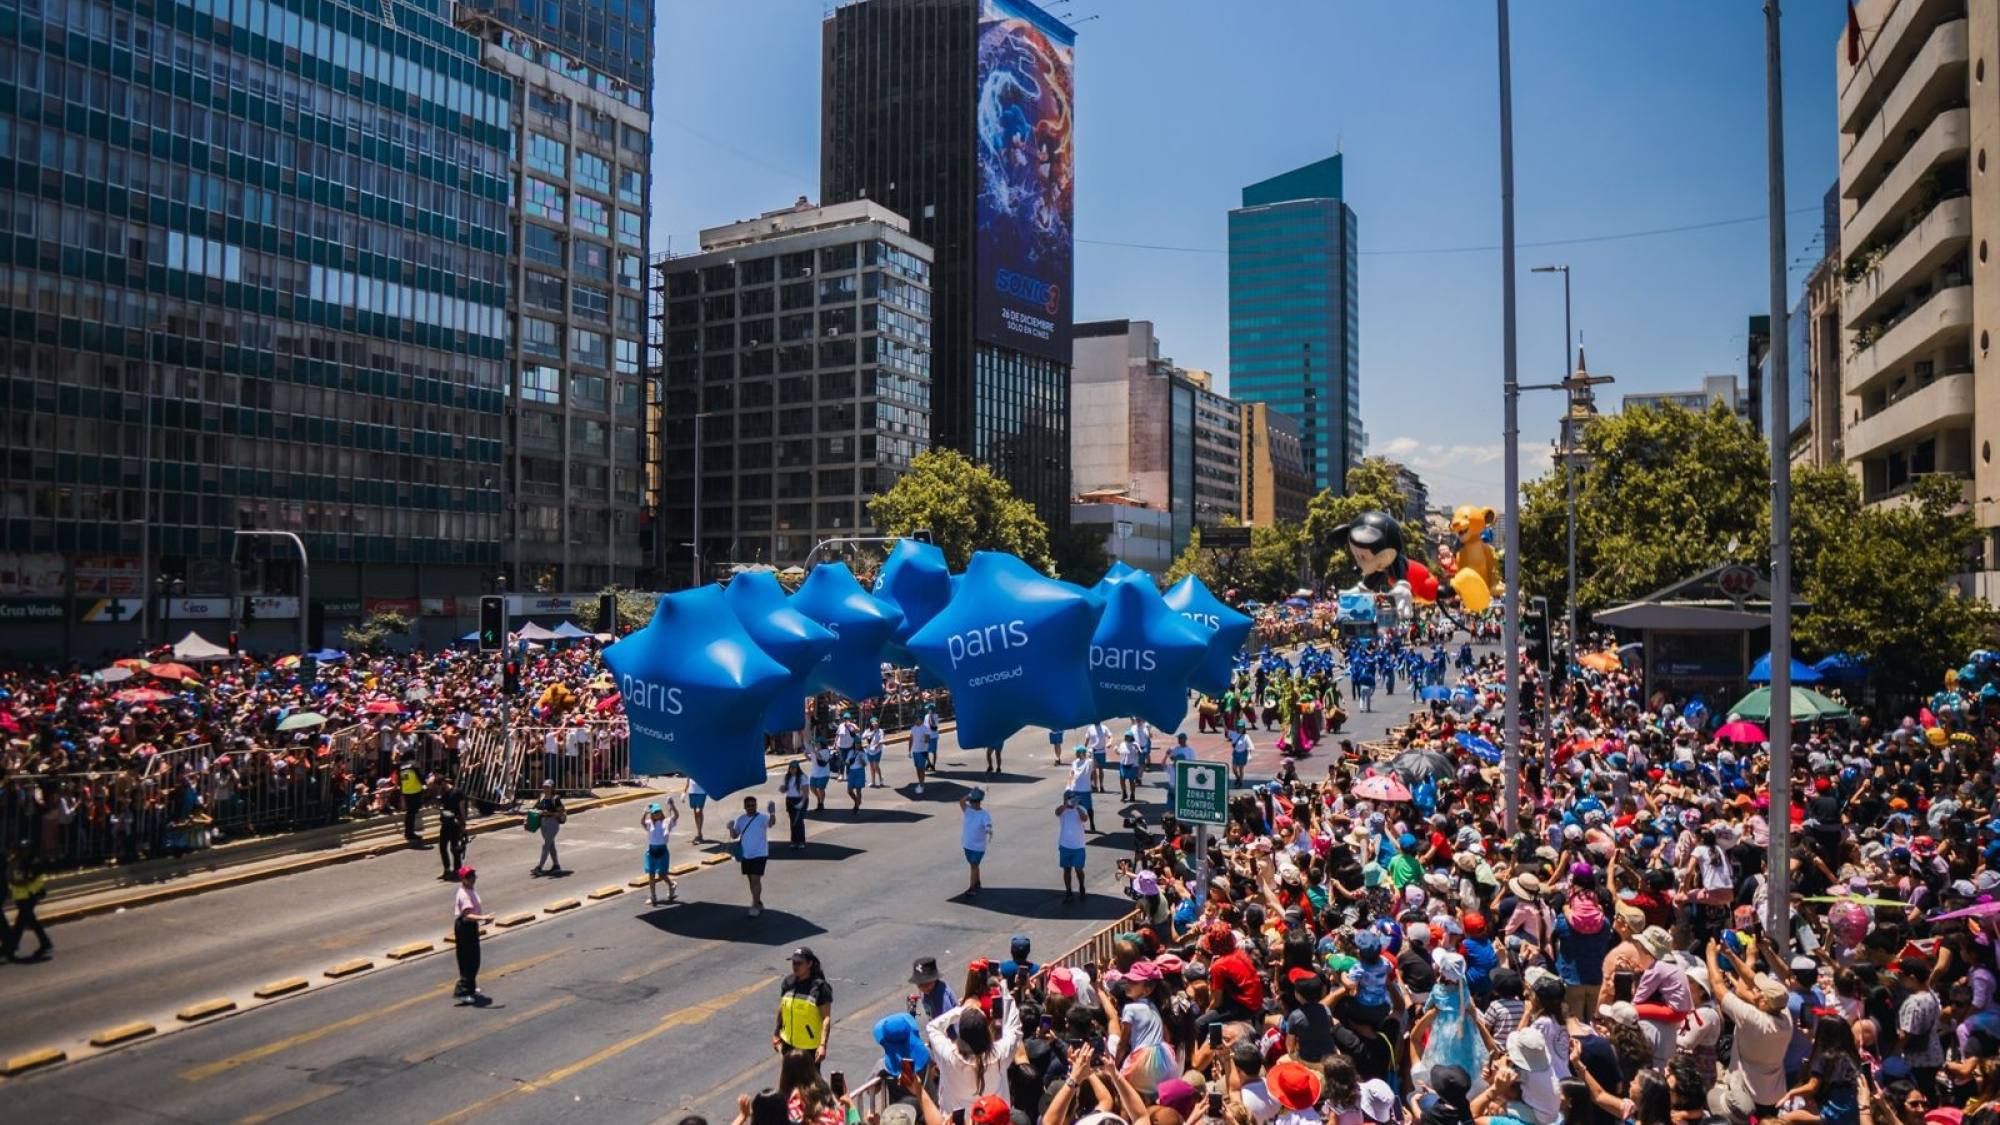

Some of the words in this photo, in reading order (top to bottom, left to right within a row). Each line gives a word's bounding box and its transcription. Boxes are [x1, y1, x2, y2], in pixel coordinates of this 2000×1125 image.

[995, 267, 1050, 305] SONIC
[1046, 284, 1060, 315] 3
[1010, 310, 1020, 321] DE
[1019, 312, 1055, 333] DICIEMBRE
[1024, 325, 1032, 335] EN
[1032, 328, 1049, 340] CINES
[0, 605, 26, 616] Cruz
[27, 605, 63, 616] Verde
[947, 619, 1028, 670] paris
[1089, 644, 1157, 671] paris
[968, 665, 1023, 687] cencosud
[1099, 681, 1146, 693] cencosud
[623, 673, 683, 715] paris
[1186, 789, 1205, 800] ZONA
[1206, 791, 1215, 802] DE
[1186, 799, 1216, 811] CONTROL
